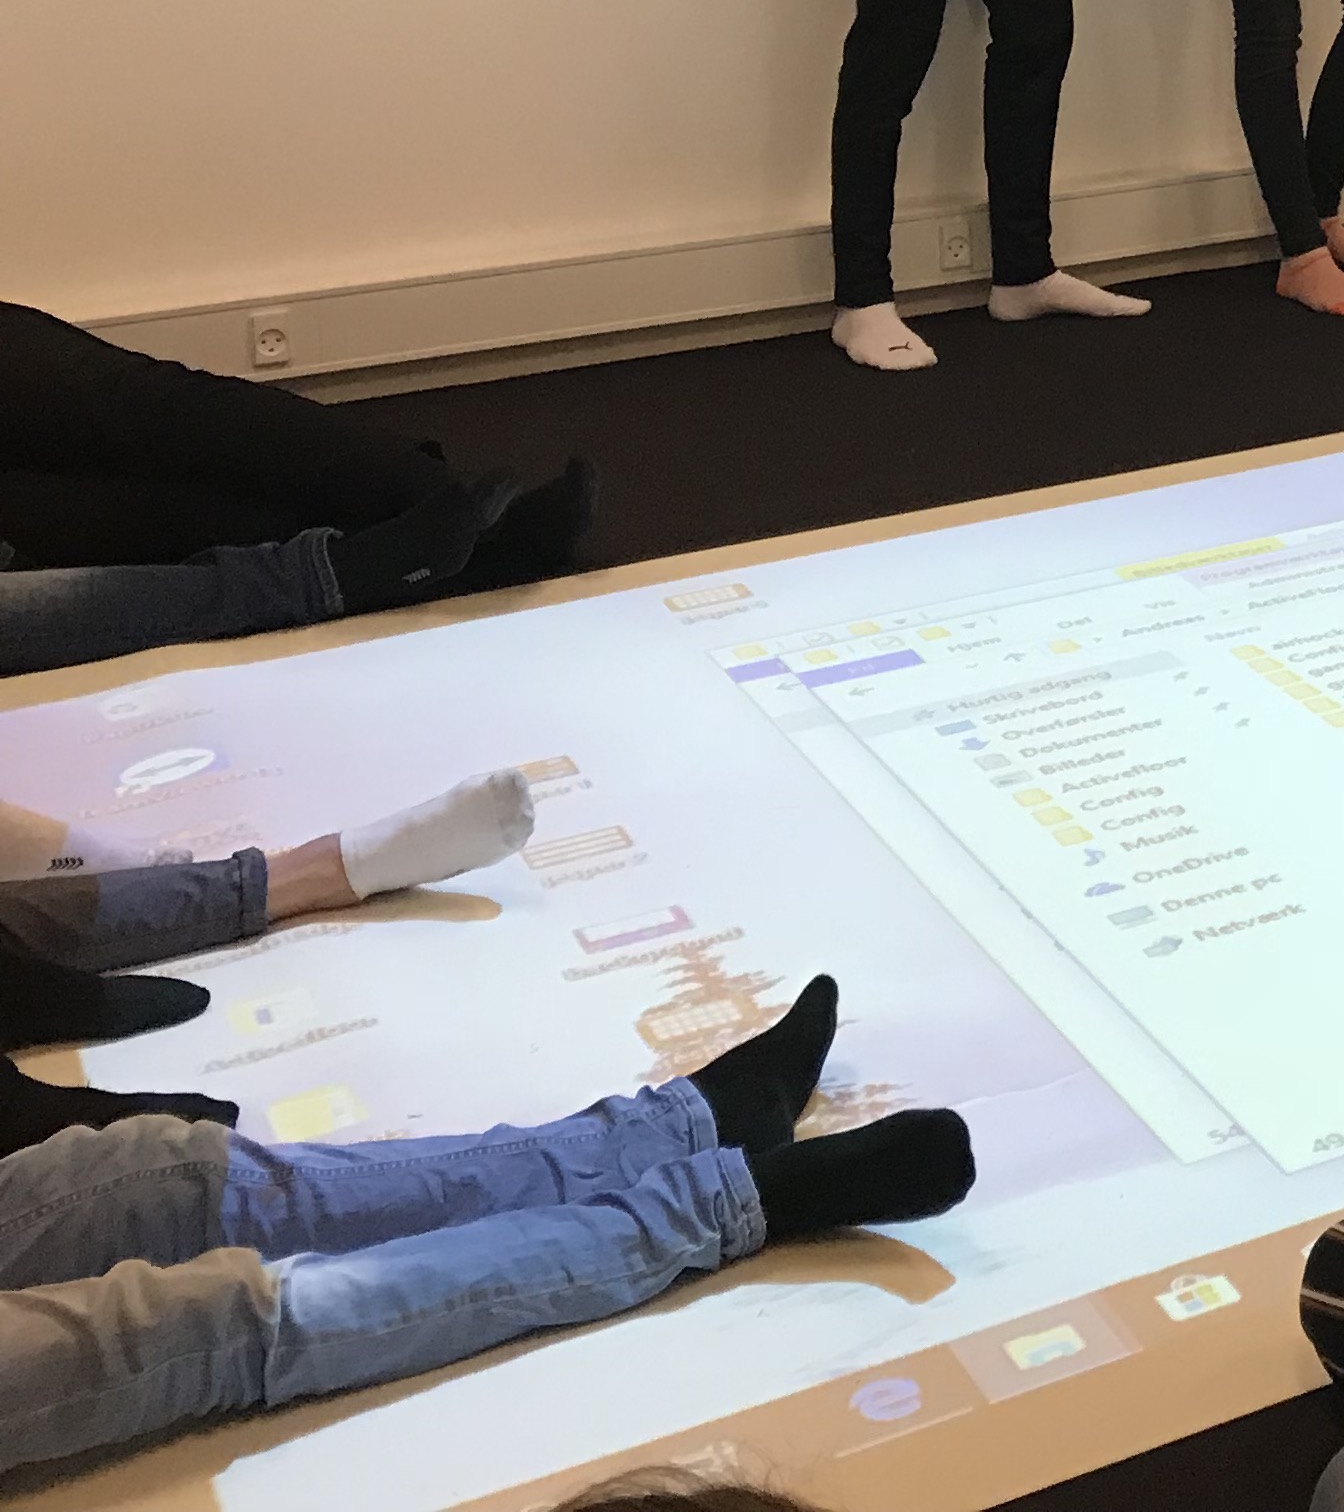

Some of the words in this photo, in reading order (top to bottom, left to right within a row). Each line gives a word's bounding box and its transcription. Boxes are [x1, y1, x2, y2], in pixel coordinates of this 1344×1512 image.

[1056, 616, 1092, 629] Del
[1121, 615, 1204, 637] Andreas
[946, 691, 1023, 712] Hurtig
[1028, 671, 1112, 693] adgang
[982, 691, 1102, 724] Skrivebord
[1019, 719, 1161, 757] Dokumenter
[1038, 749, 1124, 775] Billeder
[1061, 756, 1186, 792] Activefloor
[1079, 786, 1164, 811] Config
[1100, 804, 1185, 830] Config
[1119, 825, 1198, 851] Musik
[1132, 847, 1248, 883] OneDrive
[1160, 884, 1246, 912] Denne
[1250, 873, 1282, 890] pc
[1192, 904, 1304, 940] Netværk
